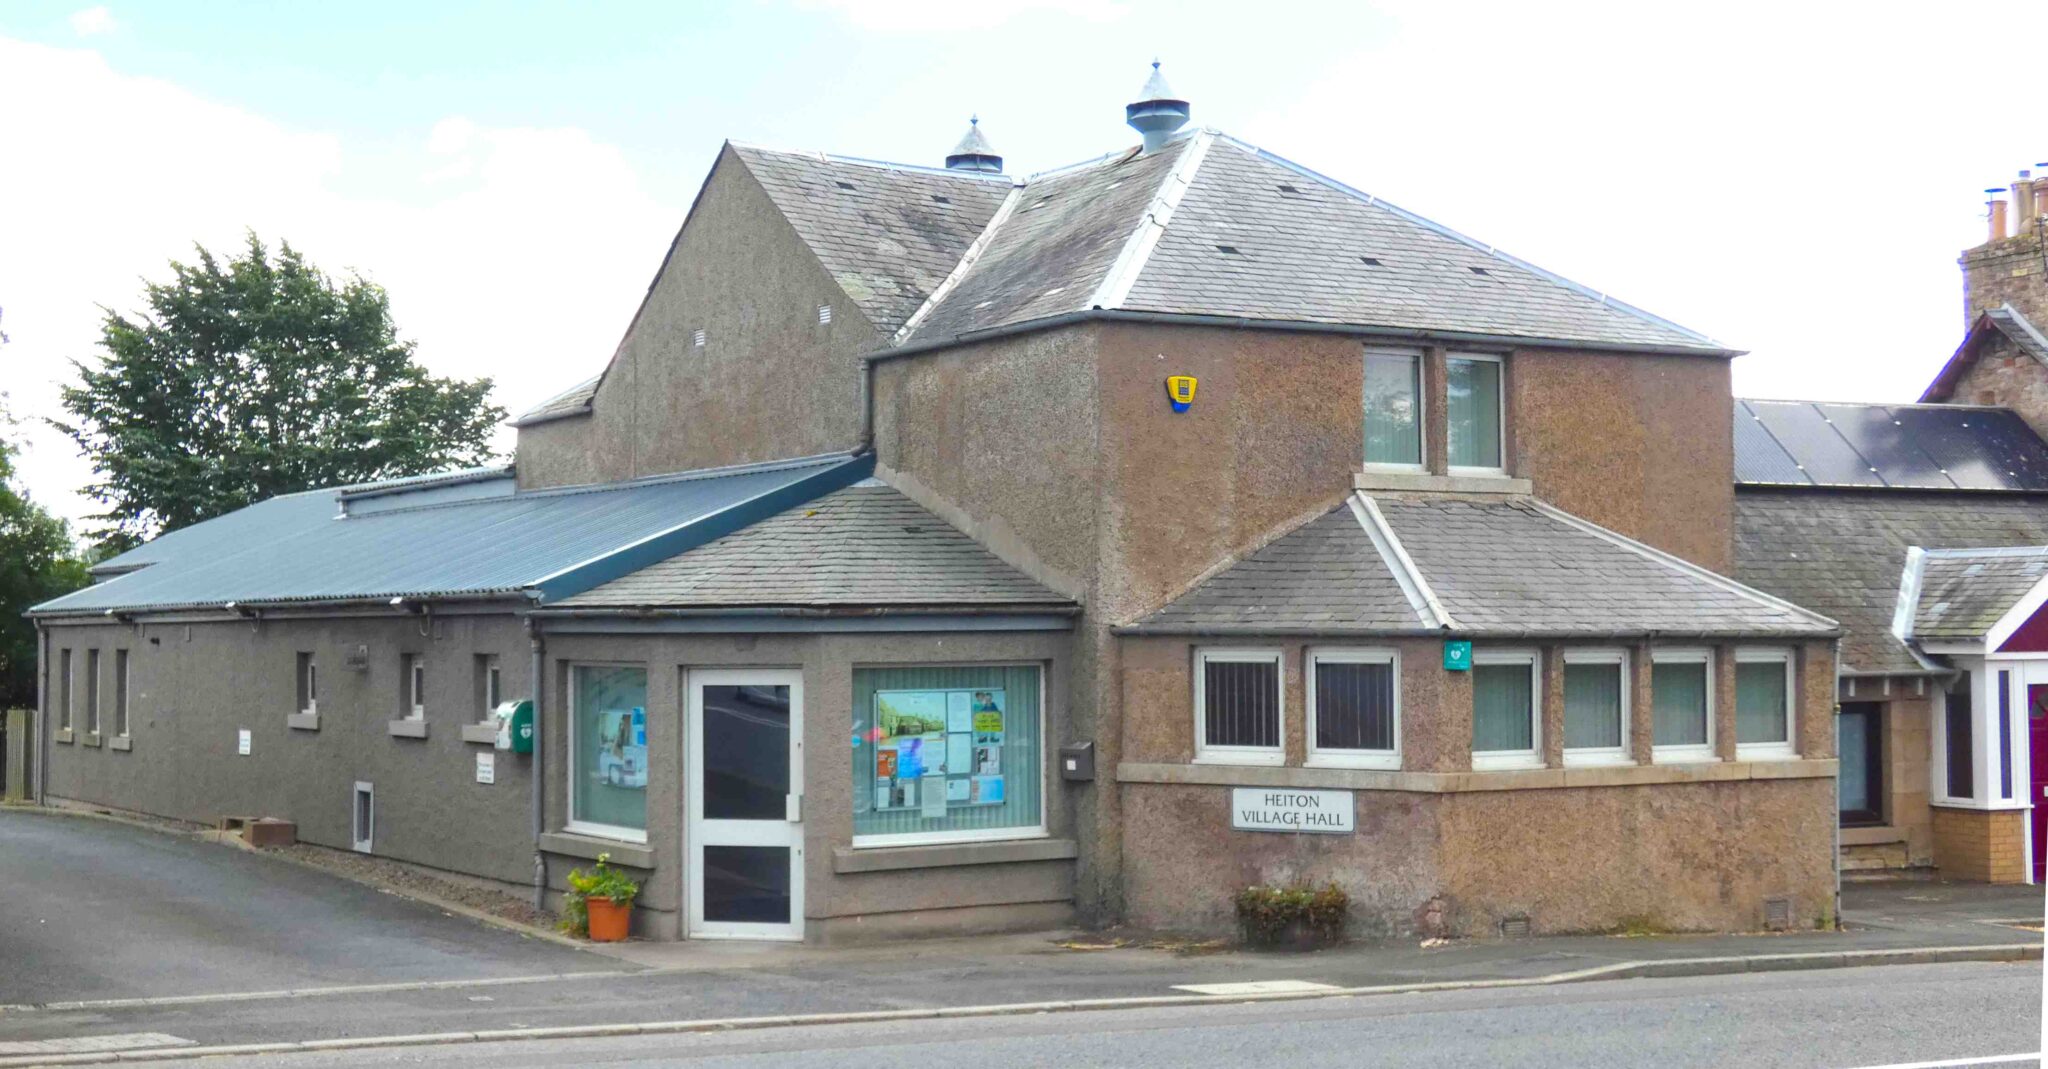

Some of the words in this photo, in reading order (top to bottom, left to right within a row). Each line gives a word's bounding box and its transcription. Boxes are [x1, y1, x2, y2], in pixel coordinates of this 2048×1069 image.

[1265, 794, 1320, 807] HEITON
[1242, 811, 1300, 825] VILLAGE
[1306, 813, 1344, 826] HALL
